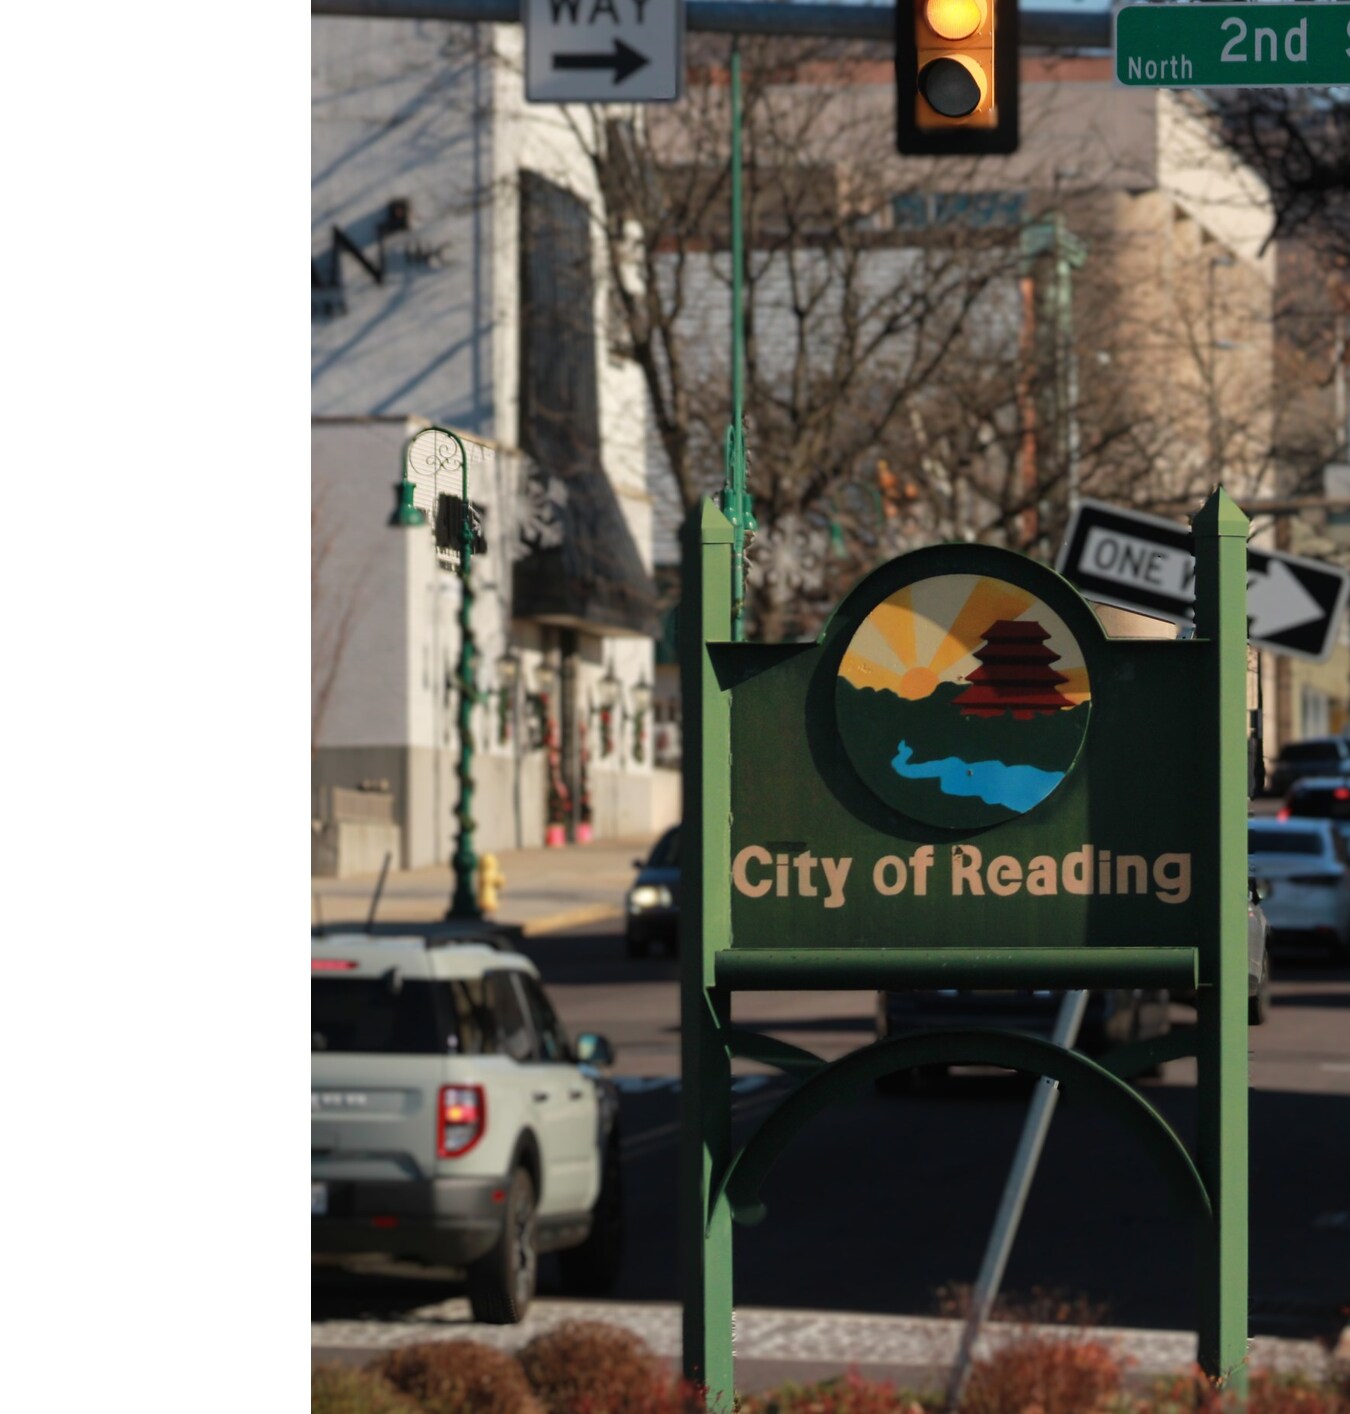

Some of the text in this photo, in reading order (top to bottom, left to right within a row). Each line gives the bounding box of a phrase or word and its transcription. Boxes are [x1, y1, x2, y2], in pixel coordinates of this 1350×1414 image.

[1219, 16, 1308, 63] 2nd
[1127, 54, 1193, 80] North
[1093, 537, 1172, 586] ONE
[731, 843, 1192, 908] City of Reading
